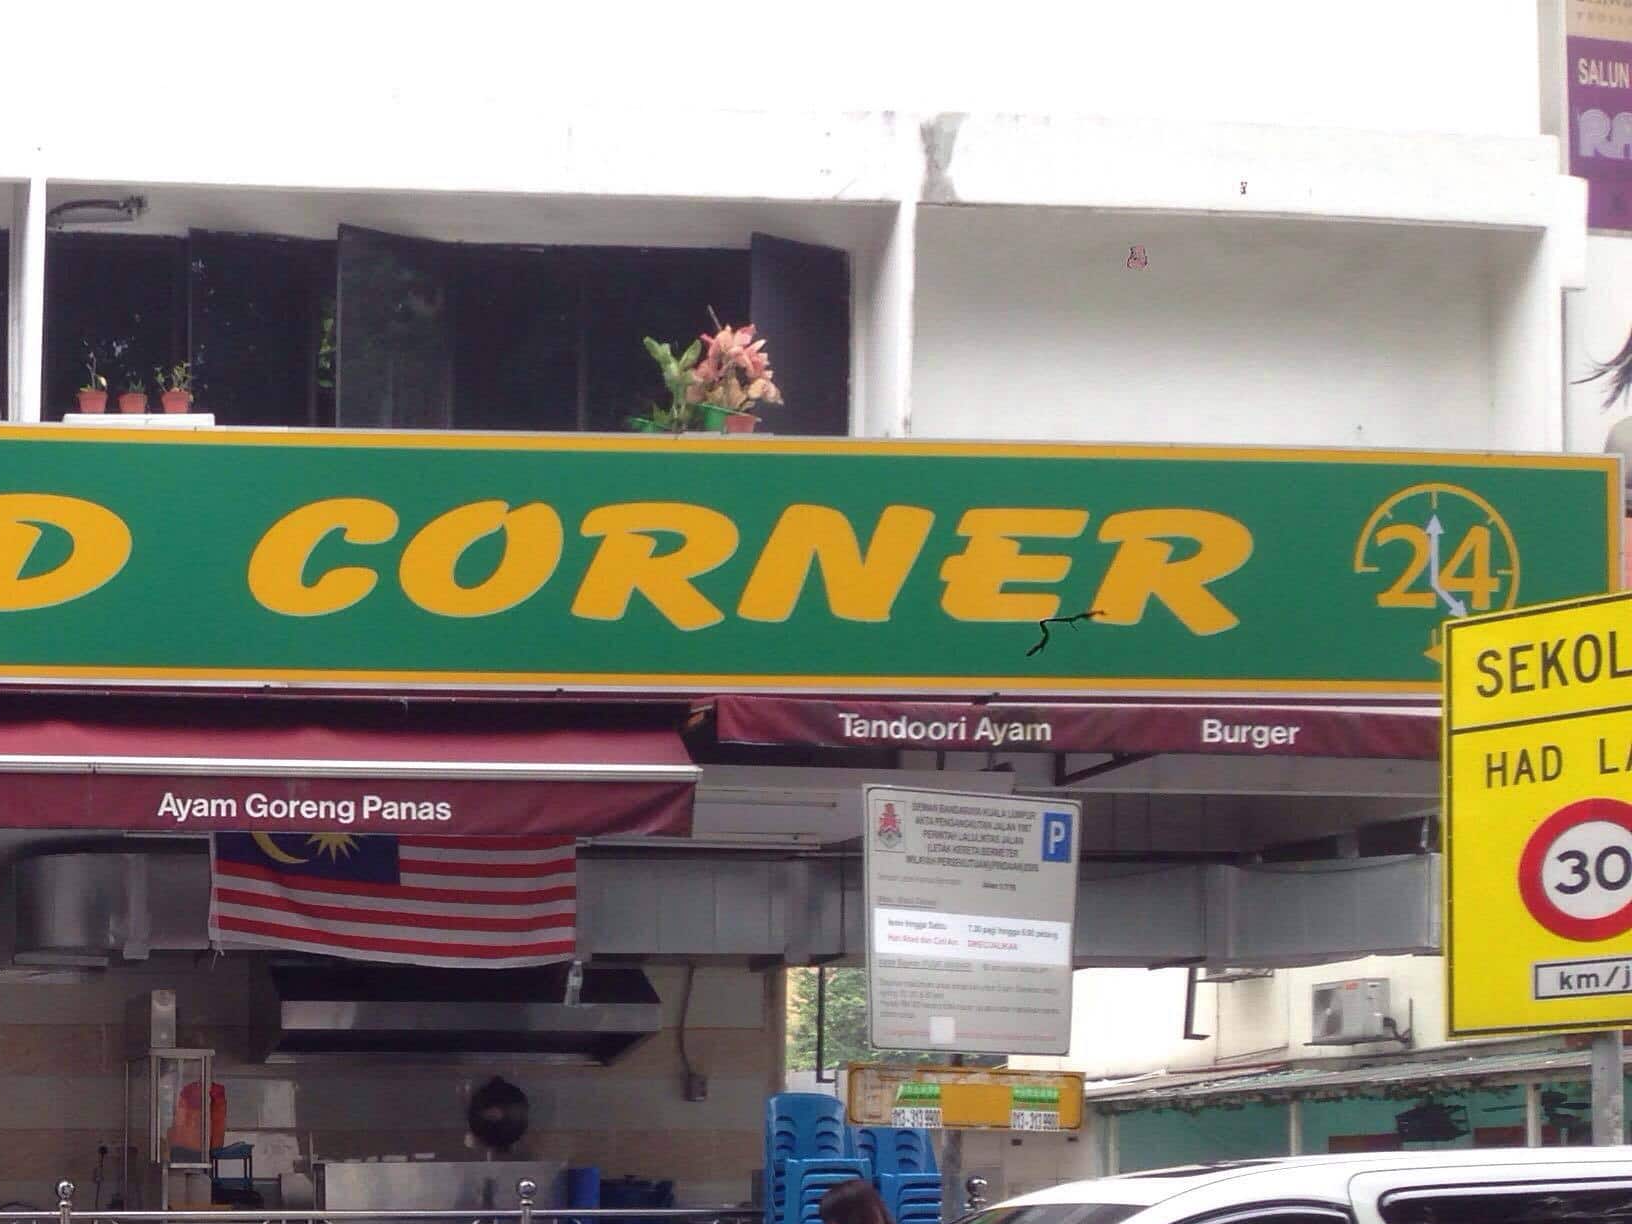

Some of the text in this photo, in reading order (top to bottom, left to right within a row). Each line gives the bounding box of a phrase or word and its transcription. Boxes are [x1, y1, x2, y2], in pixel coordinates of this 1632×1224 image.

[1577, 58, 1630, 88] SALUN
[248, 498, 1251, 632] CORNER
[1376, 524, 1499, 609] 24
[838, 713, 1051, 745] Tandoori Ayam
[1203, 719, 1300, 748] Burger
[1486, 745, 1563, 788] HAD
[158, 793, 451, 824] Ayam Goreng Panas
[1050, 820, 1065, 854] P
[1554, 845, 1632, 895] 30
